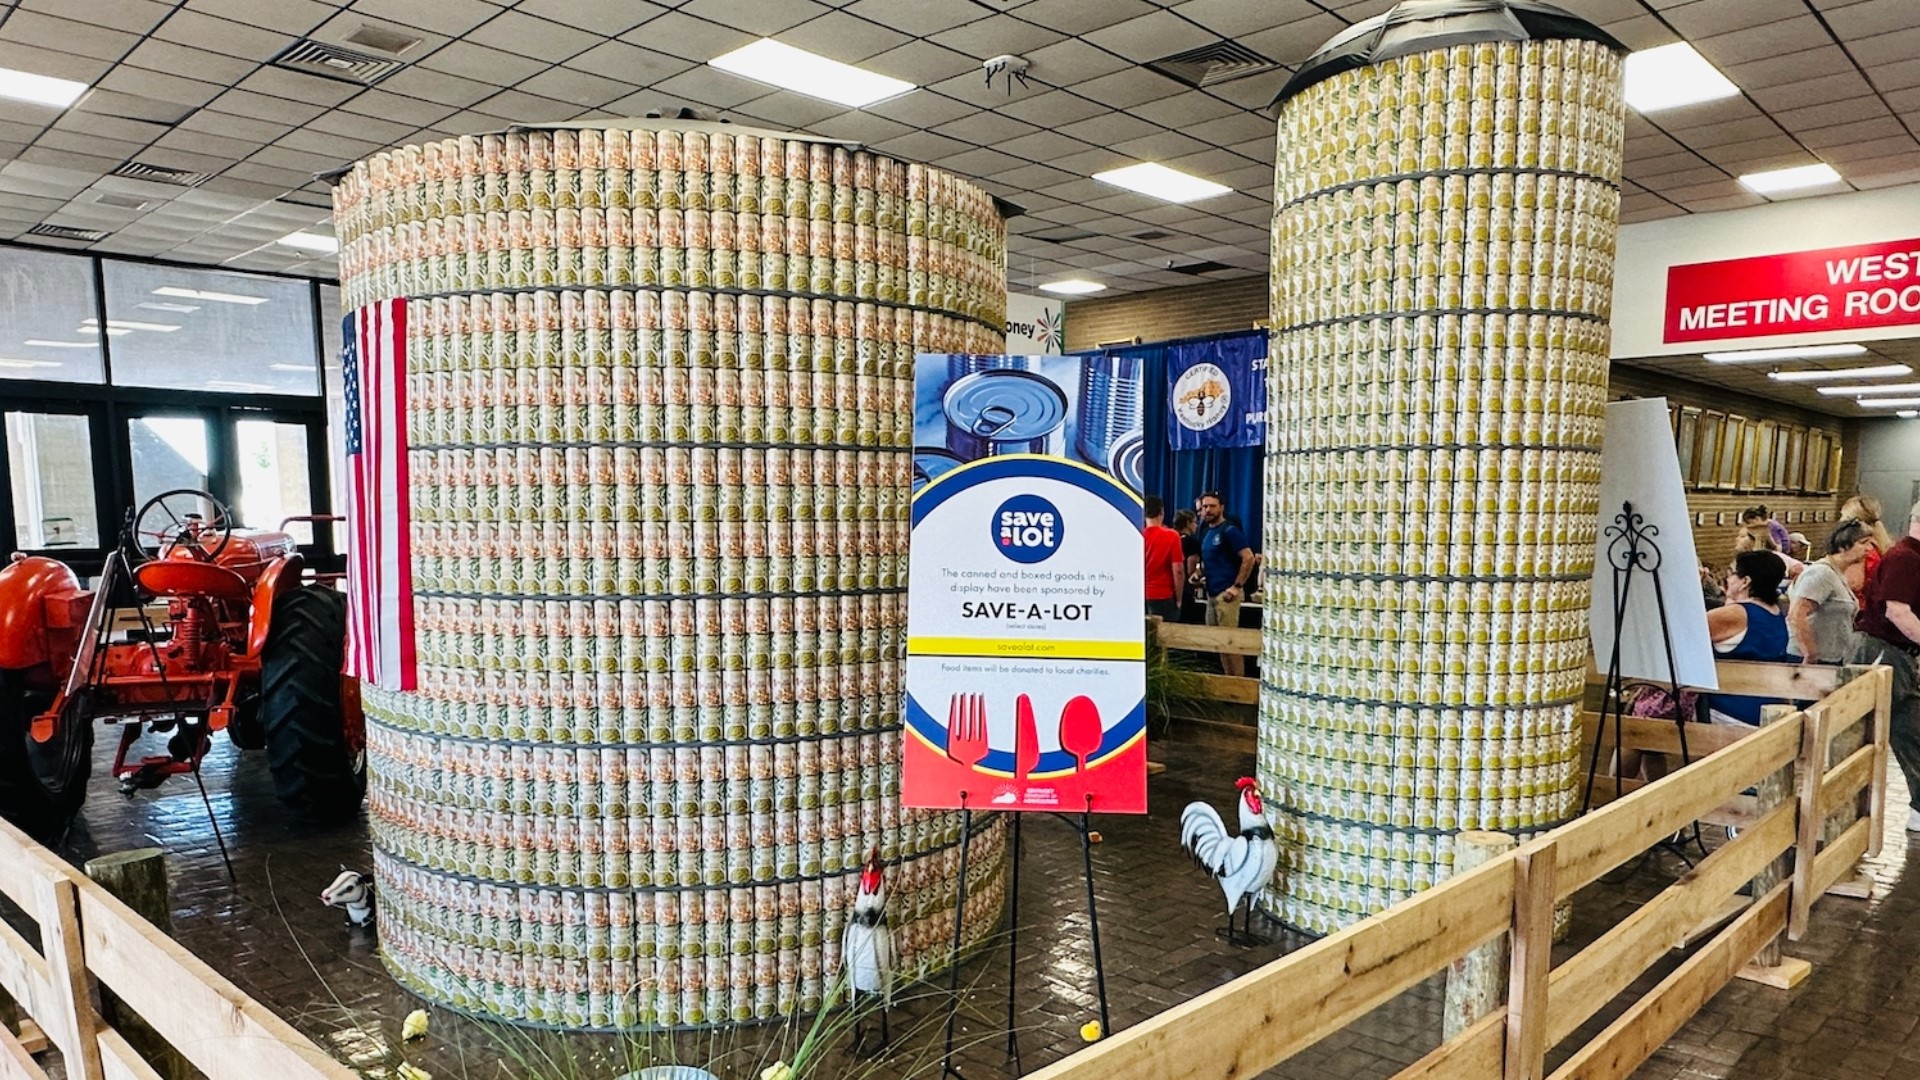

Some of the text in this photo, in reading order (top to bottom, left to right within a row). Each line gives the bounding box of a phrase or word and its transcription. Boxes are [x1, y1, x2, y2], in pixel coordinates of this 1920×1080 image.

[1678, 294, 1828, 331] MEETING
[1001, 511, 1054, 527] save
[941, 568, 1115, 582] The canned and boxed goods in this
[987, 583, 1011, 593] have
[1013, 583, 1038, 594] been
[1041, 585, 1090, 596] sponsored
[1092, 586, 1105, 597] by
[962, 601, 1093, 621] SAVE-A-LOT
[941, 663, 960, 672] Food
[963, 663, 982, 672] items
[984, 663, 998, 672] will
[999, 664, 1010, 673] be
[1011, 664, 1044, 674] donated
[1045, 666, 1054, 674] to
[1055, 666, 1074, 675] local
